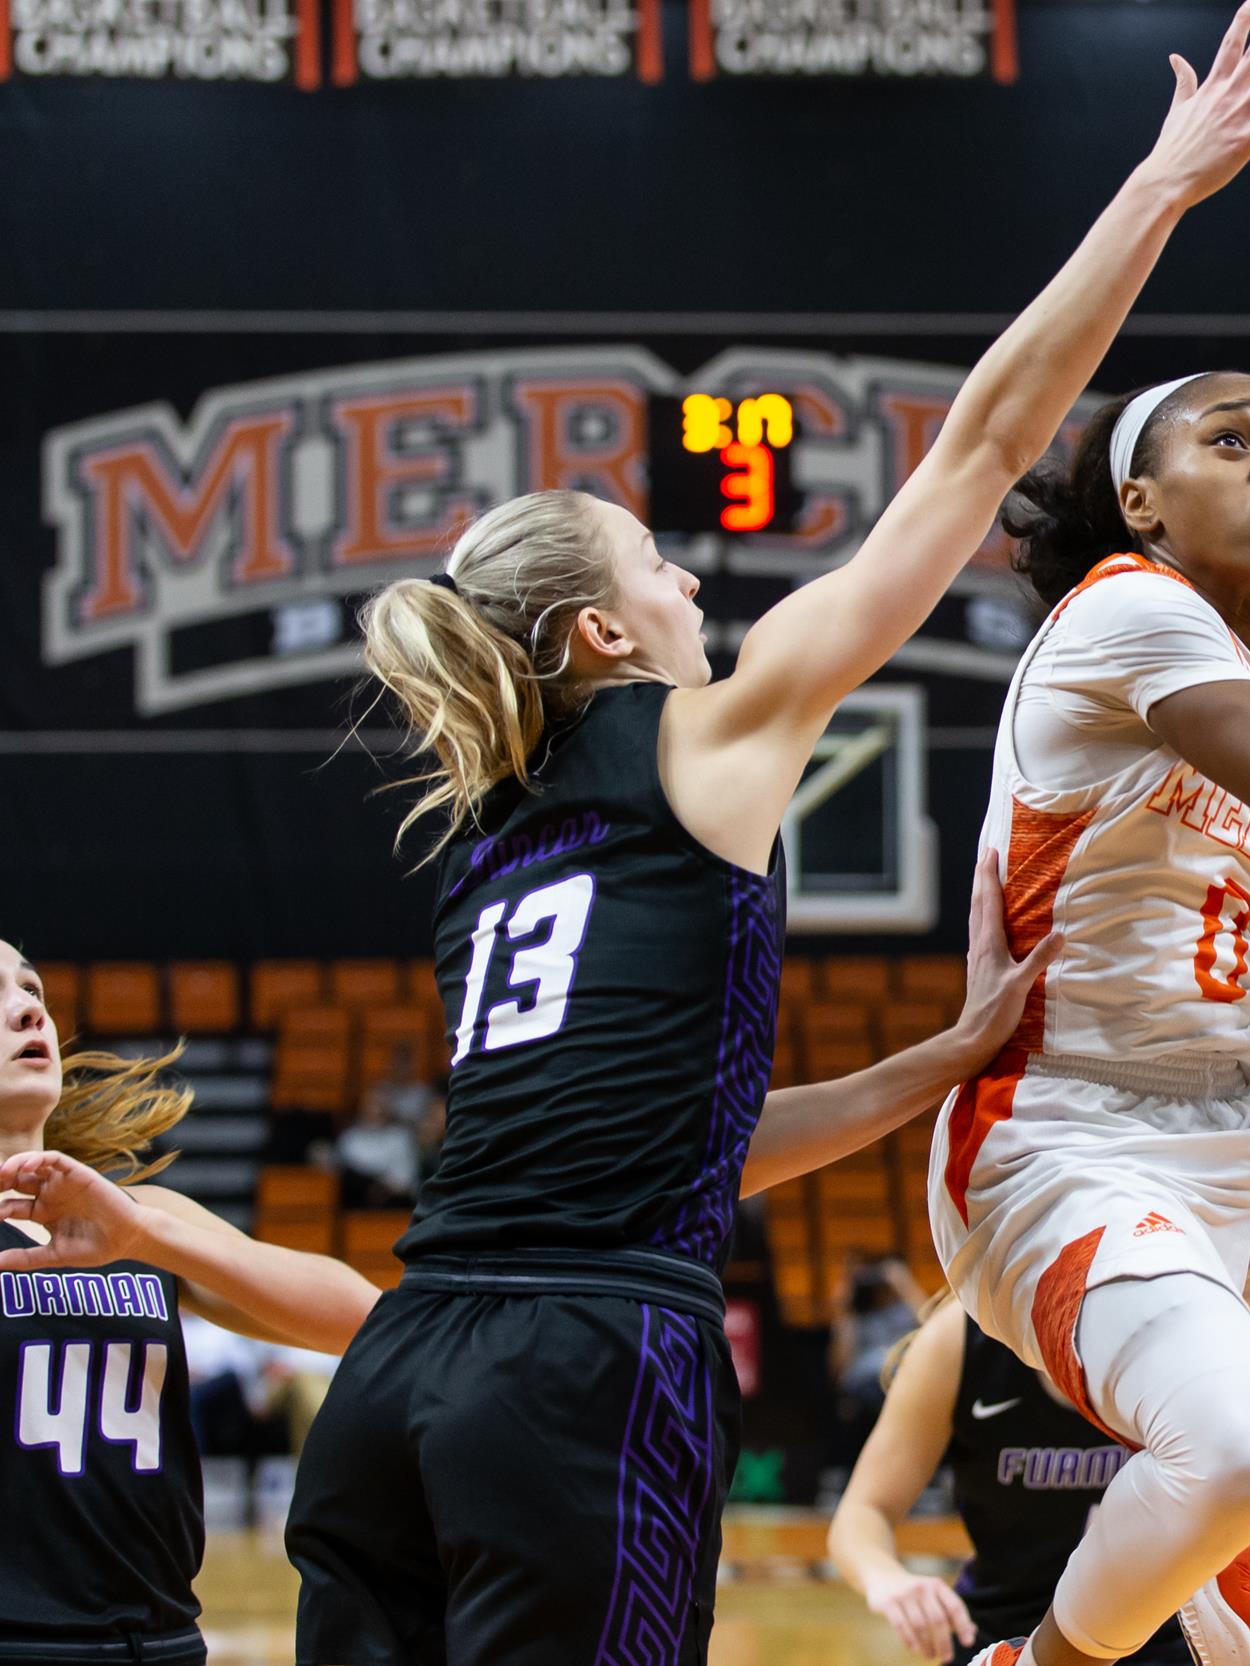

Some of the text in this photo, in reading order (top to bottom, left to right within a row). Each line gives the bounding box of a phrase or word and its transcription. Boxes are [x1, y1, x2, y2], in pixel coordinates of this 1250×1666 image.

[14, 31, 288, 81] CHAMPIONS
[359, 29, 630, 78] CHAMPIONS
[715, 27, 985, 76] CHAMPIONS
[720, 440, 775, 532] 3
[451, 871, 597, 1069] 13
[1132, 1225, 1186, 1238] adidas
[15, 1339, 169, 1477] 44
[998, 1447, 1136, 1489] FURM
